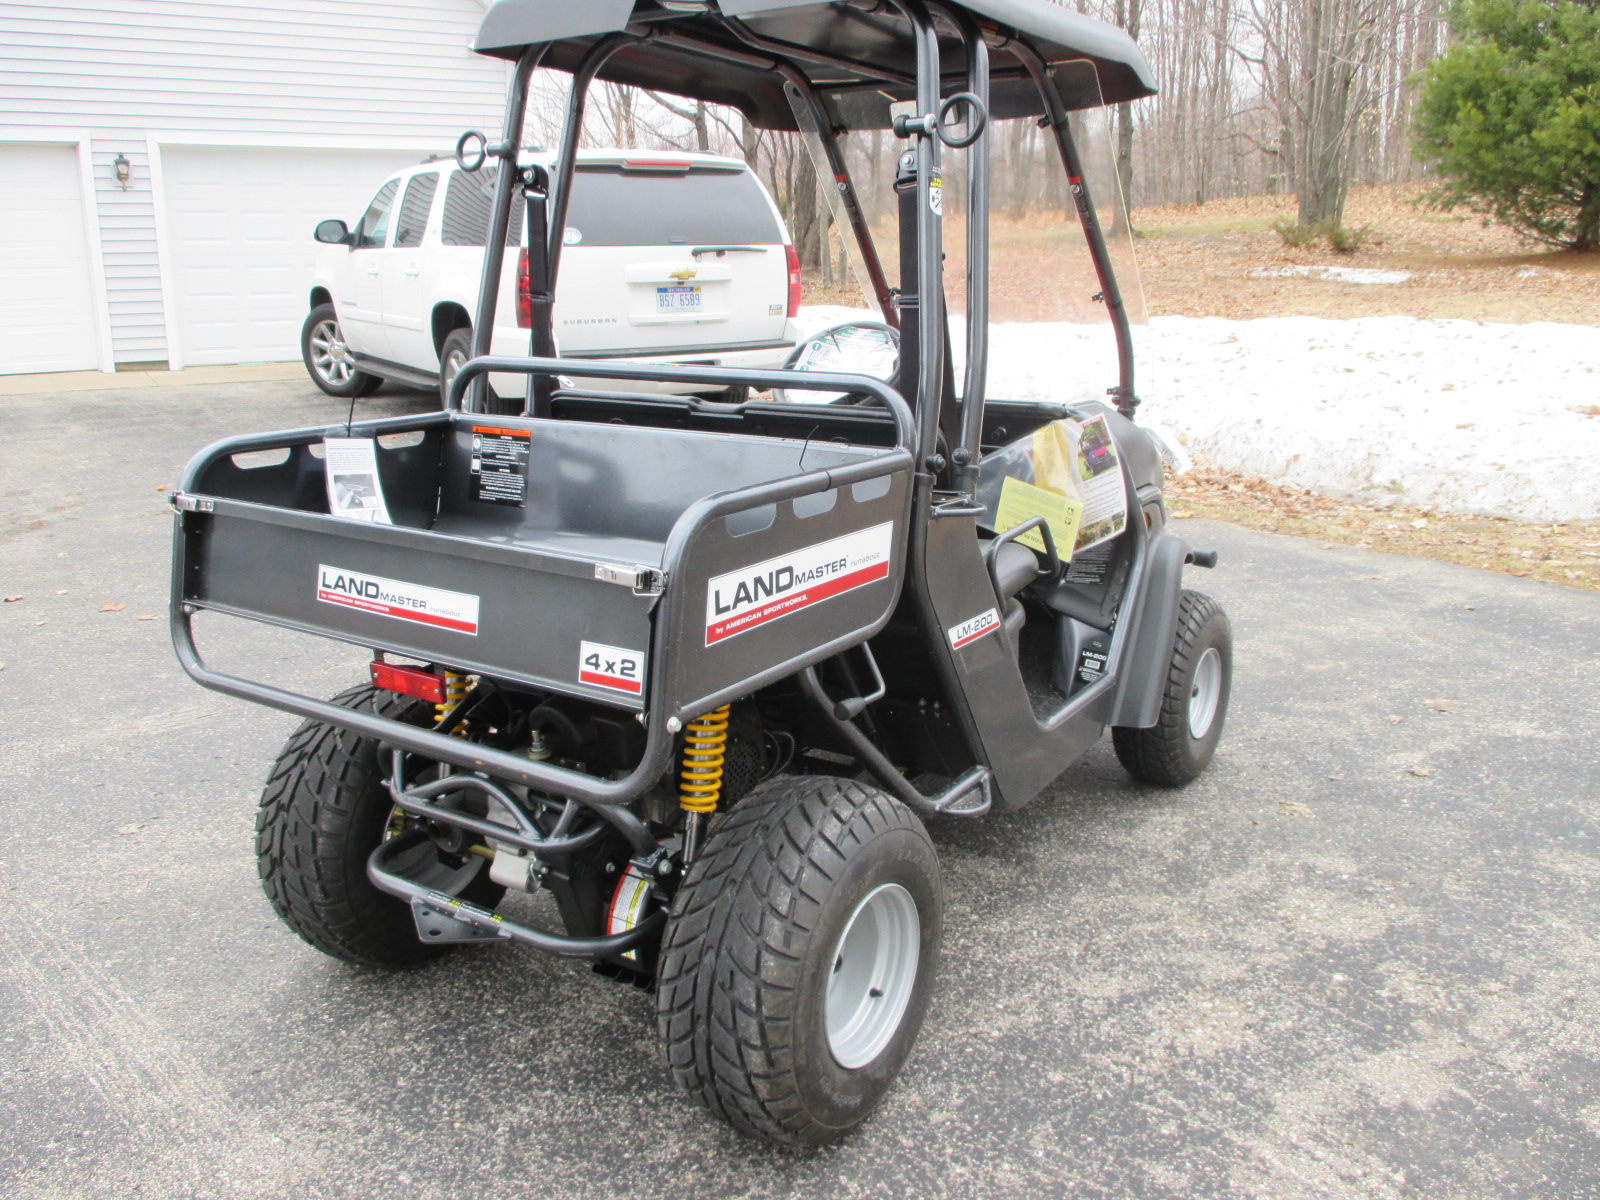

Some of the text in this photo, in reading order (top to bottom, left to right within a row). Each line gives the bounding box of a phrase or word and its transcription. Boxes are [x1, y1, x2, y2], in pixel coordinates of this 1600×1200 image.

[659, 293, 701, 307] BSZ 6589
[328, 594, 354, 605] AMERICAN
[715, 626, 724, 634] by
[725, 612, 762, 631] AMERICAN
[1082, 650, 1107, 661] LM-200
[585, 653, 636, 678] 4x2
